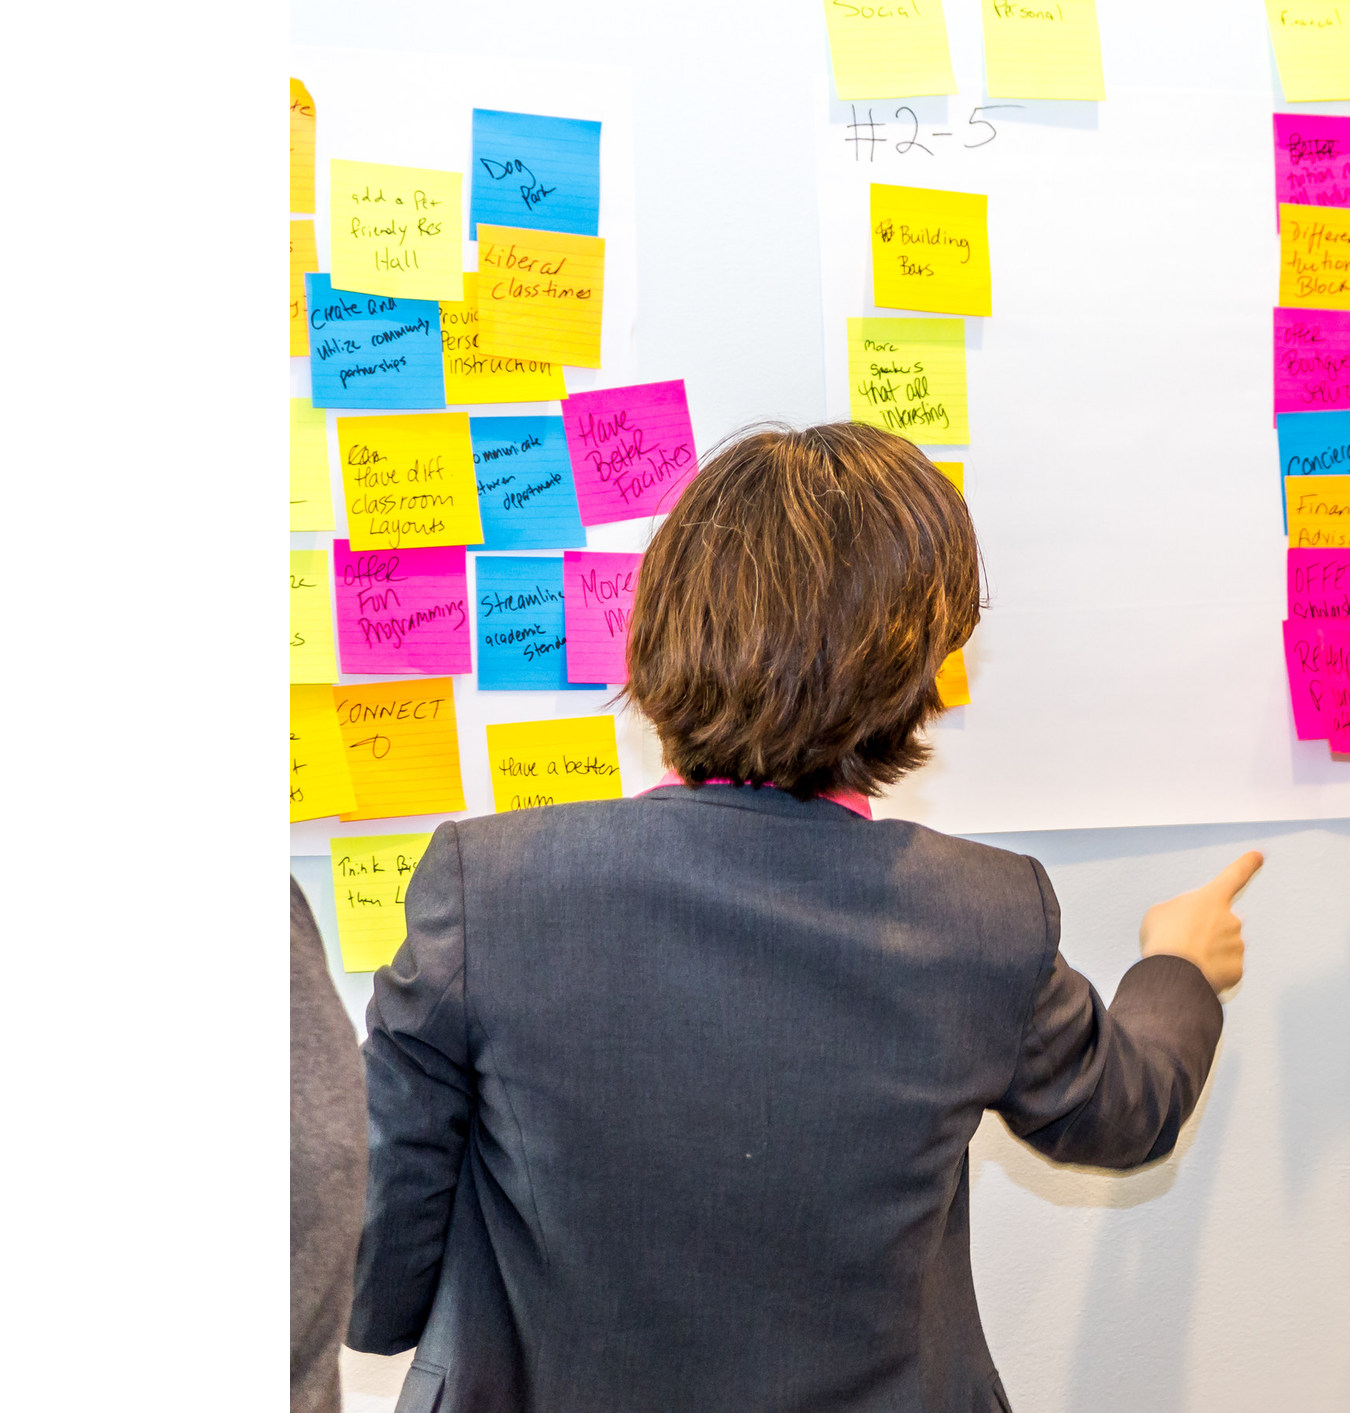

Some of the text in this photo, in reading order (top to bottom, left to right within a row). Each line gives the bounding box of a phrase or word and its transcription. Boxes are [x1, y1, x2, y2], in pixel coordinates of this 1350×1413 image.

[479, 157, 537, 190] Dog
[351, 186, 386, 204] add
[394, 196, 405, 206] a
[519, 183, 557, 211] Park
[350, 216, 408, 247] friendly
[899, 224, 972, 265] Building
[375, 246, 420, 272] Hall
[483, 244, 568, 276] Liberal
[310, 297, 363, 331] Create
[370, 317, 430, 347] community
[338, 354, 408, 390] partnerships
[578, 410, 636, 448] Have
[472, 434, 543, 464] ommunicate
[353, 465, 401, 488] Have
[476, 475, 517, 496] etween
[580, 567, 638, 609] More
[336, 698, 446, 727] CONNECT
[497, 754, 621, 778] Have a better
